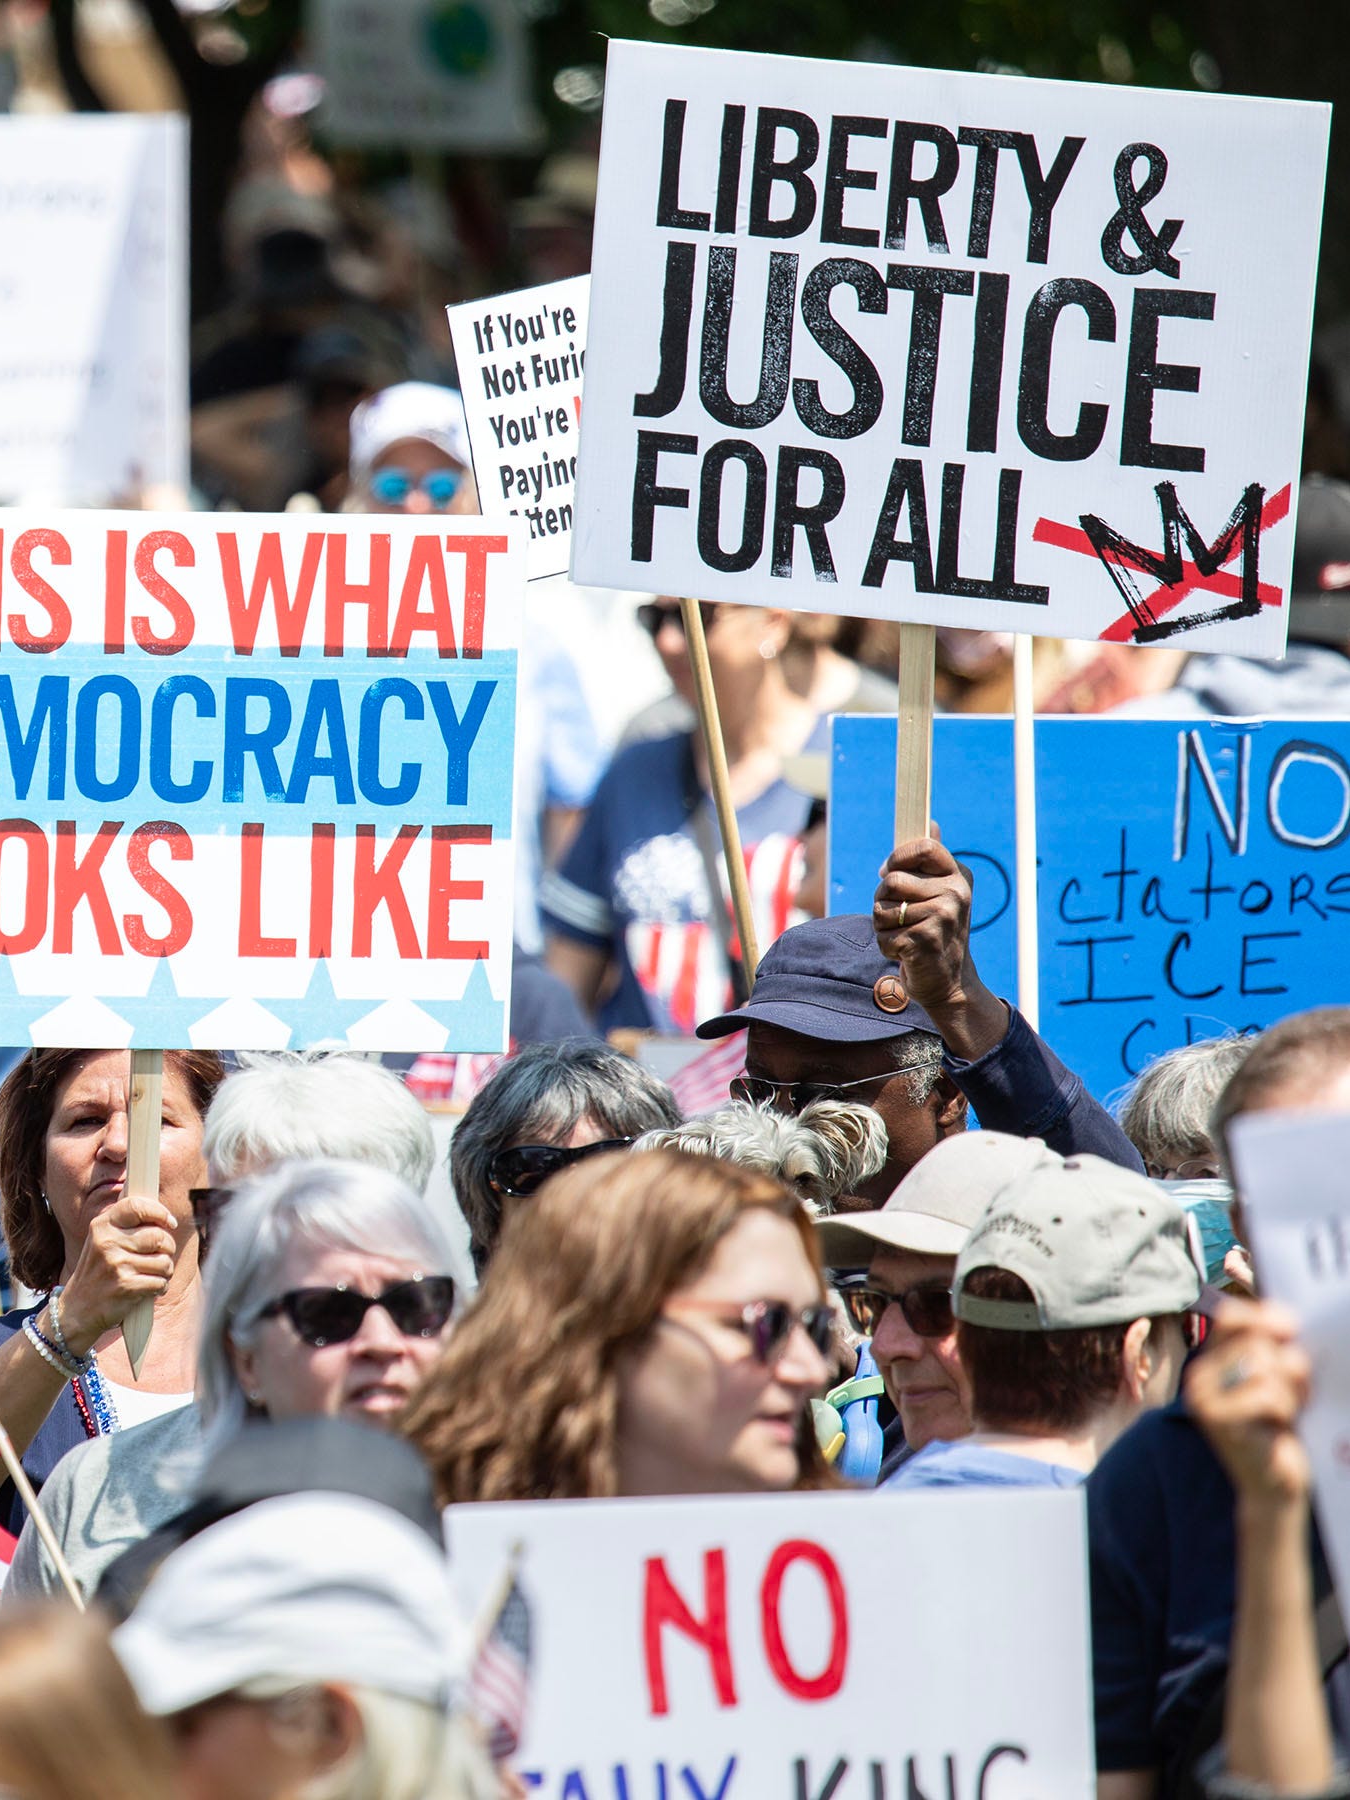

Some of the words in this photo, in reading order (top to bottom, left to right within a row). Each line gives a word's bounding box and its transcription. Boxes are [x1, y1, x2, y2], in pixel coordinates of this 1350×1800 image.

[656, 98, 1087, 265] LIBERTY
[1100, 142, 1184, 279] &
[473, 313, 495, 354] If
[498, 304, 577, 348] You're
[481, 360, 528, 400] Not
[531, 341, 586, 388] Furi
[633, 240, 1216, 473] JUSTICE
[488, 405, 569, 449] You're
[510, 504, 572, 539] tten
[630, 429, 846, 583] FOR
[861, 457, 1050, 606] ALL
[104, 529, 196, 656] IS
[216, 531, 509, 660] WHAT
[1171, 729, 1350, 863] NO
[237, 822, 493, 960] LIKE
[1054, 932, 1302, 1006] ICE
[642, 1538, 849, 1716] NO
